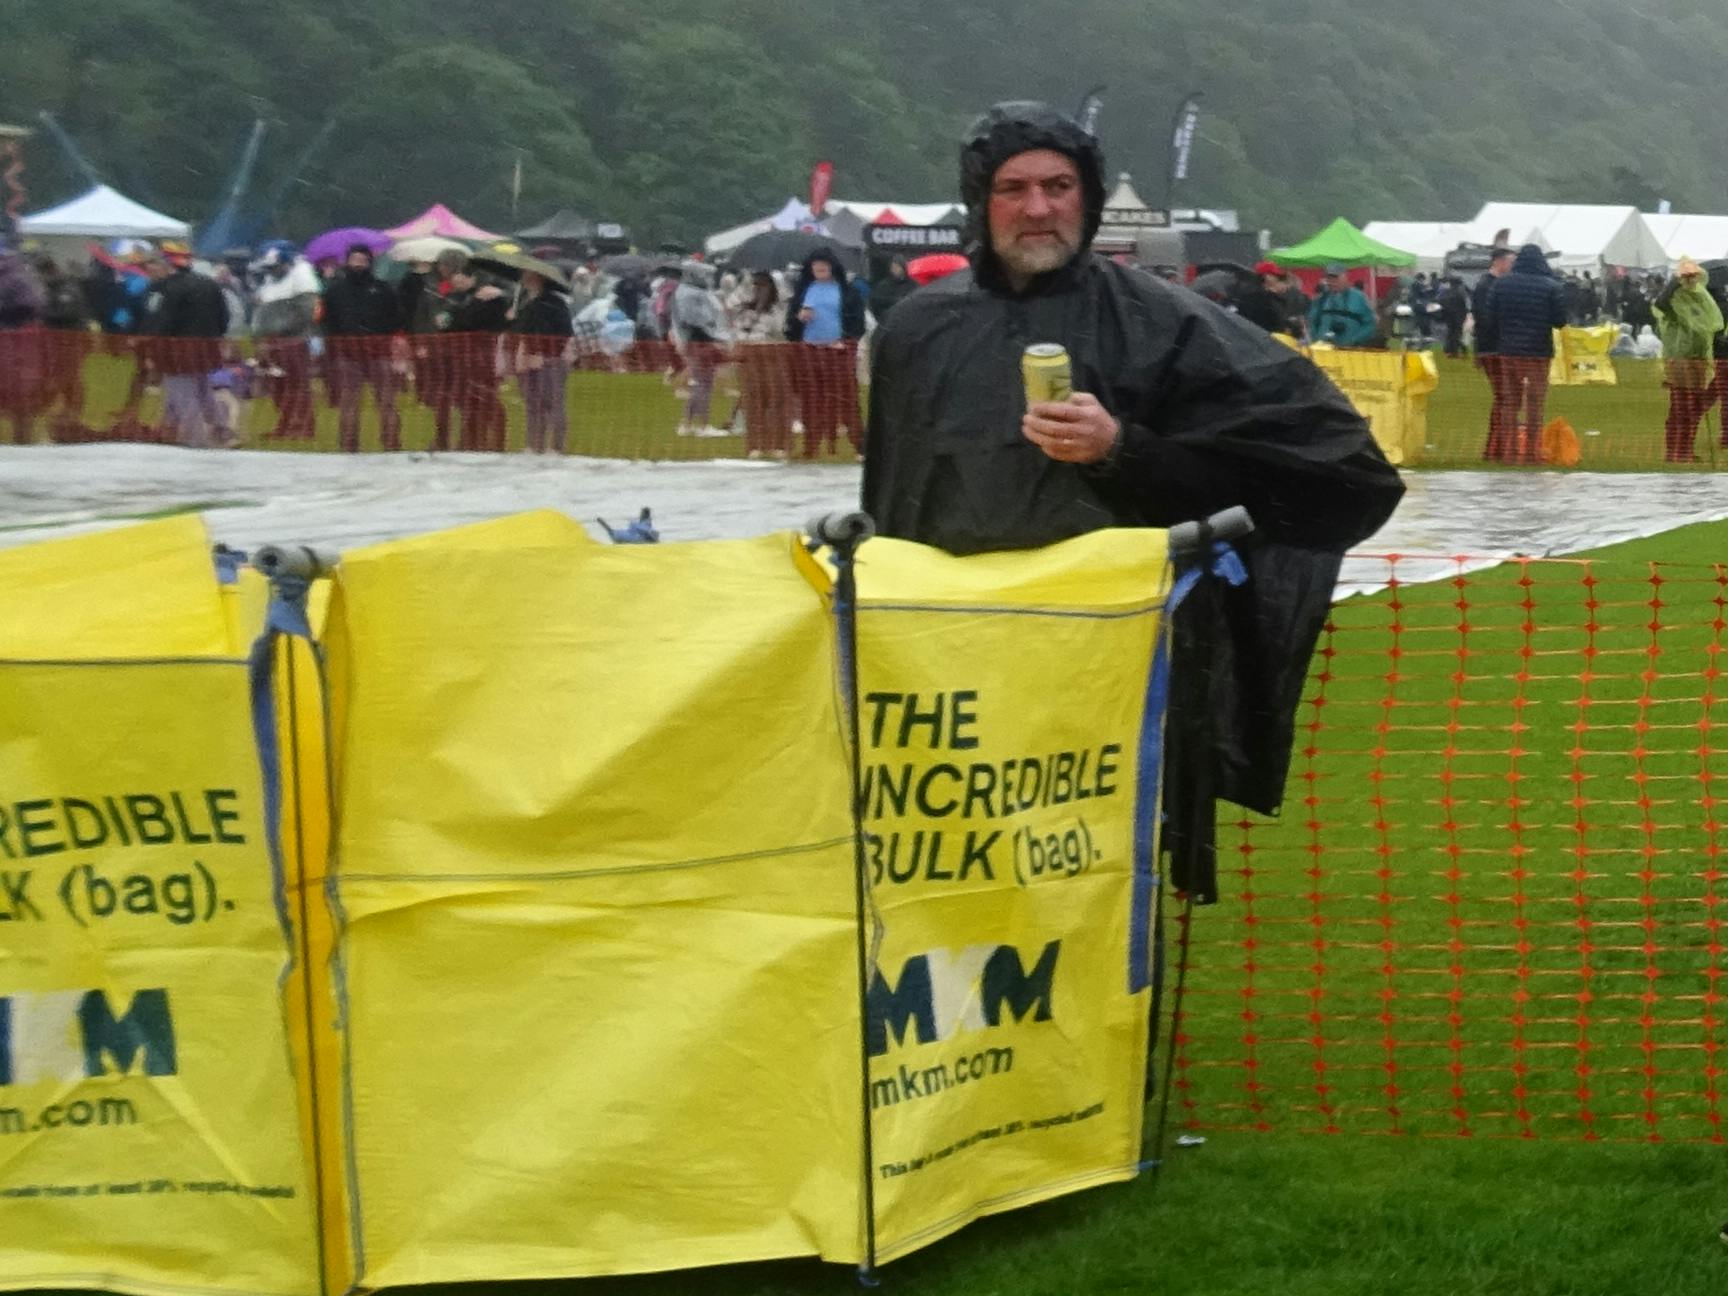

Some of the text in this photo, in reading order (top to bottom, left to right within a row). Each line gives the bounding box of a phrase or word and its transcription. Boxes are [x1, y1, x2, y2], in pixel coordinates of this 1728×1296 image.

[871, 229, 960, 245] COFFEE BAR
[865, 689, 980, 750] THE
[861, 743, 1121, 821] INCREDIBLE
[1011, 817, 1103, 888] (bag).
[57, 859, 236, 928] (bag).
[871, 1045, 1014, 1109] mkm.com
